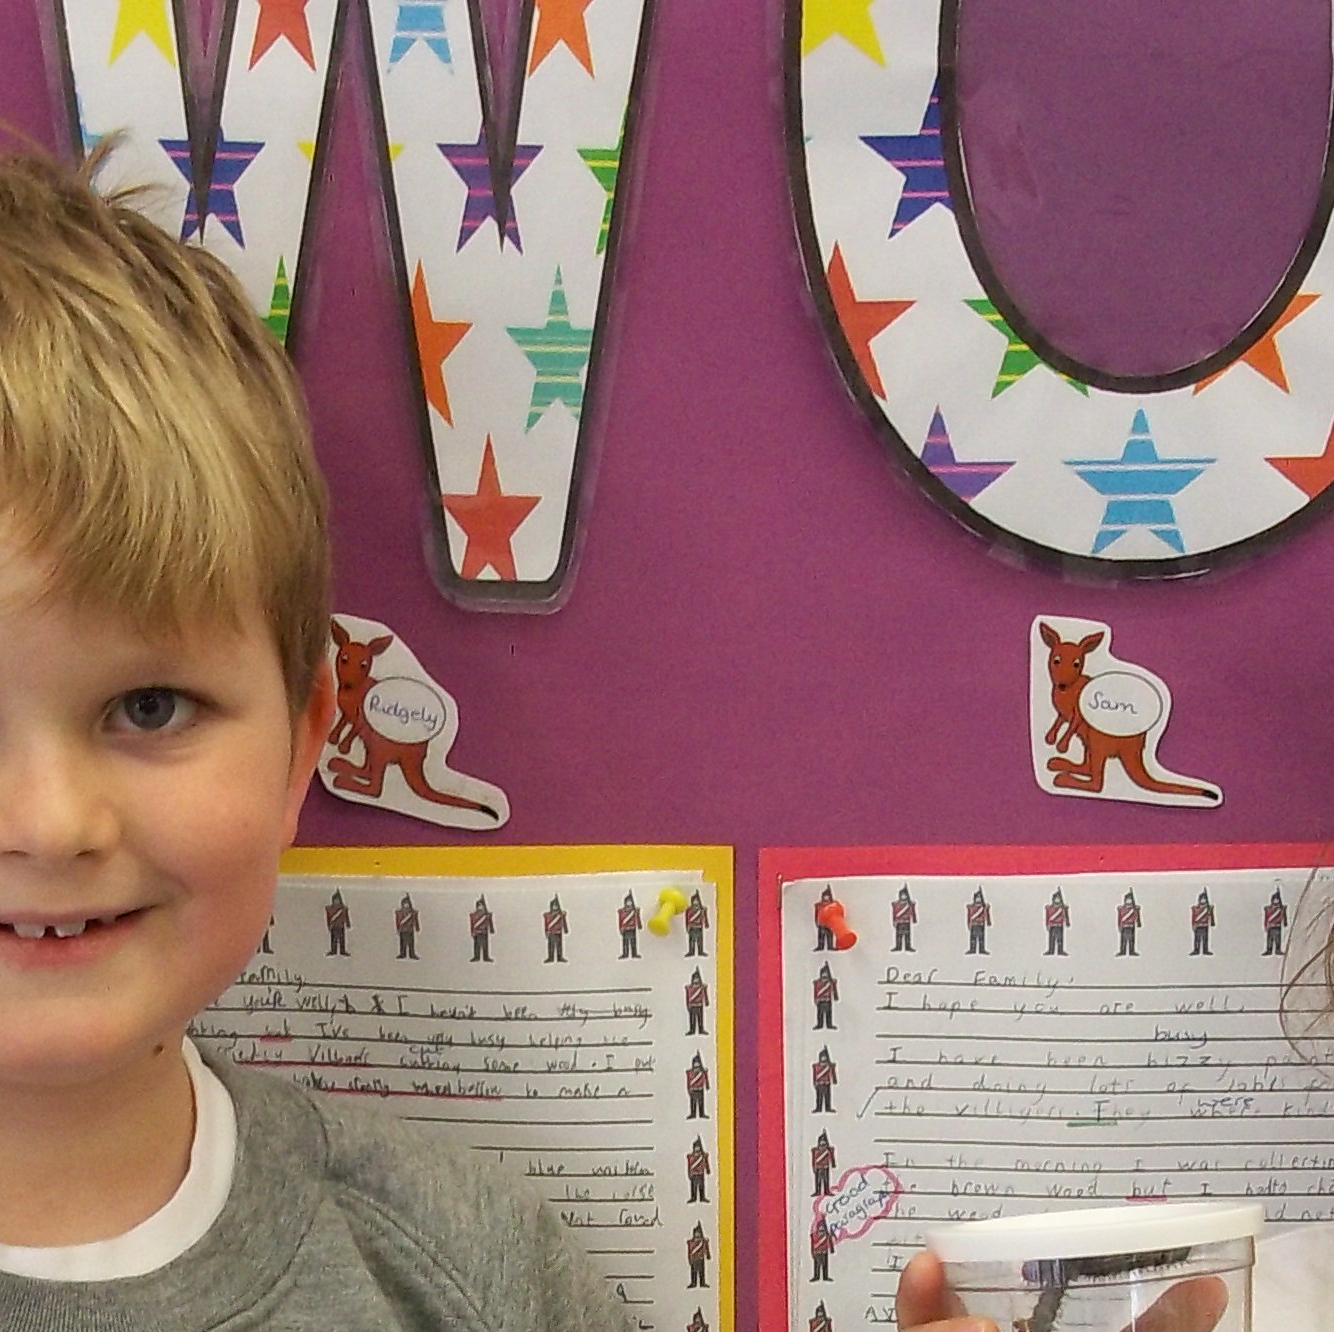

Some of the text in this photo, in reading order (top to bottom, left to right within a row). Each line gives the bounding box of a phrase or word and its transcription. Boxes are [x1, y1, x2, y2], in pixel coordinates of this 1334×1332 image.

[369, 695, 438, 731] Ridgely
[1088, 691, 1138, 715] Sam
[887, 966, 938, 984] Dear
[886, 992, 899, 1009] I
[922, 994, 978, 1020] hope
[1014, 1003, 1059, 1021] you
[1154, 1024, 1207, 1049] busy
[886, 1047, 903, 1063] I
[887, 1073, 933, 1089] and
[951, 1178, 1015, 1197] brown
[1200, 1181, 1212, 1195] I
